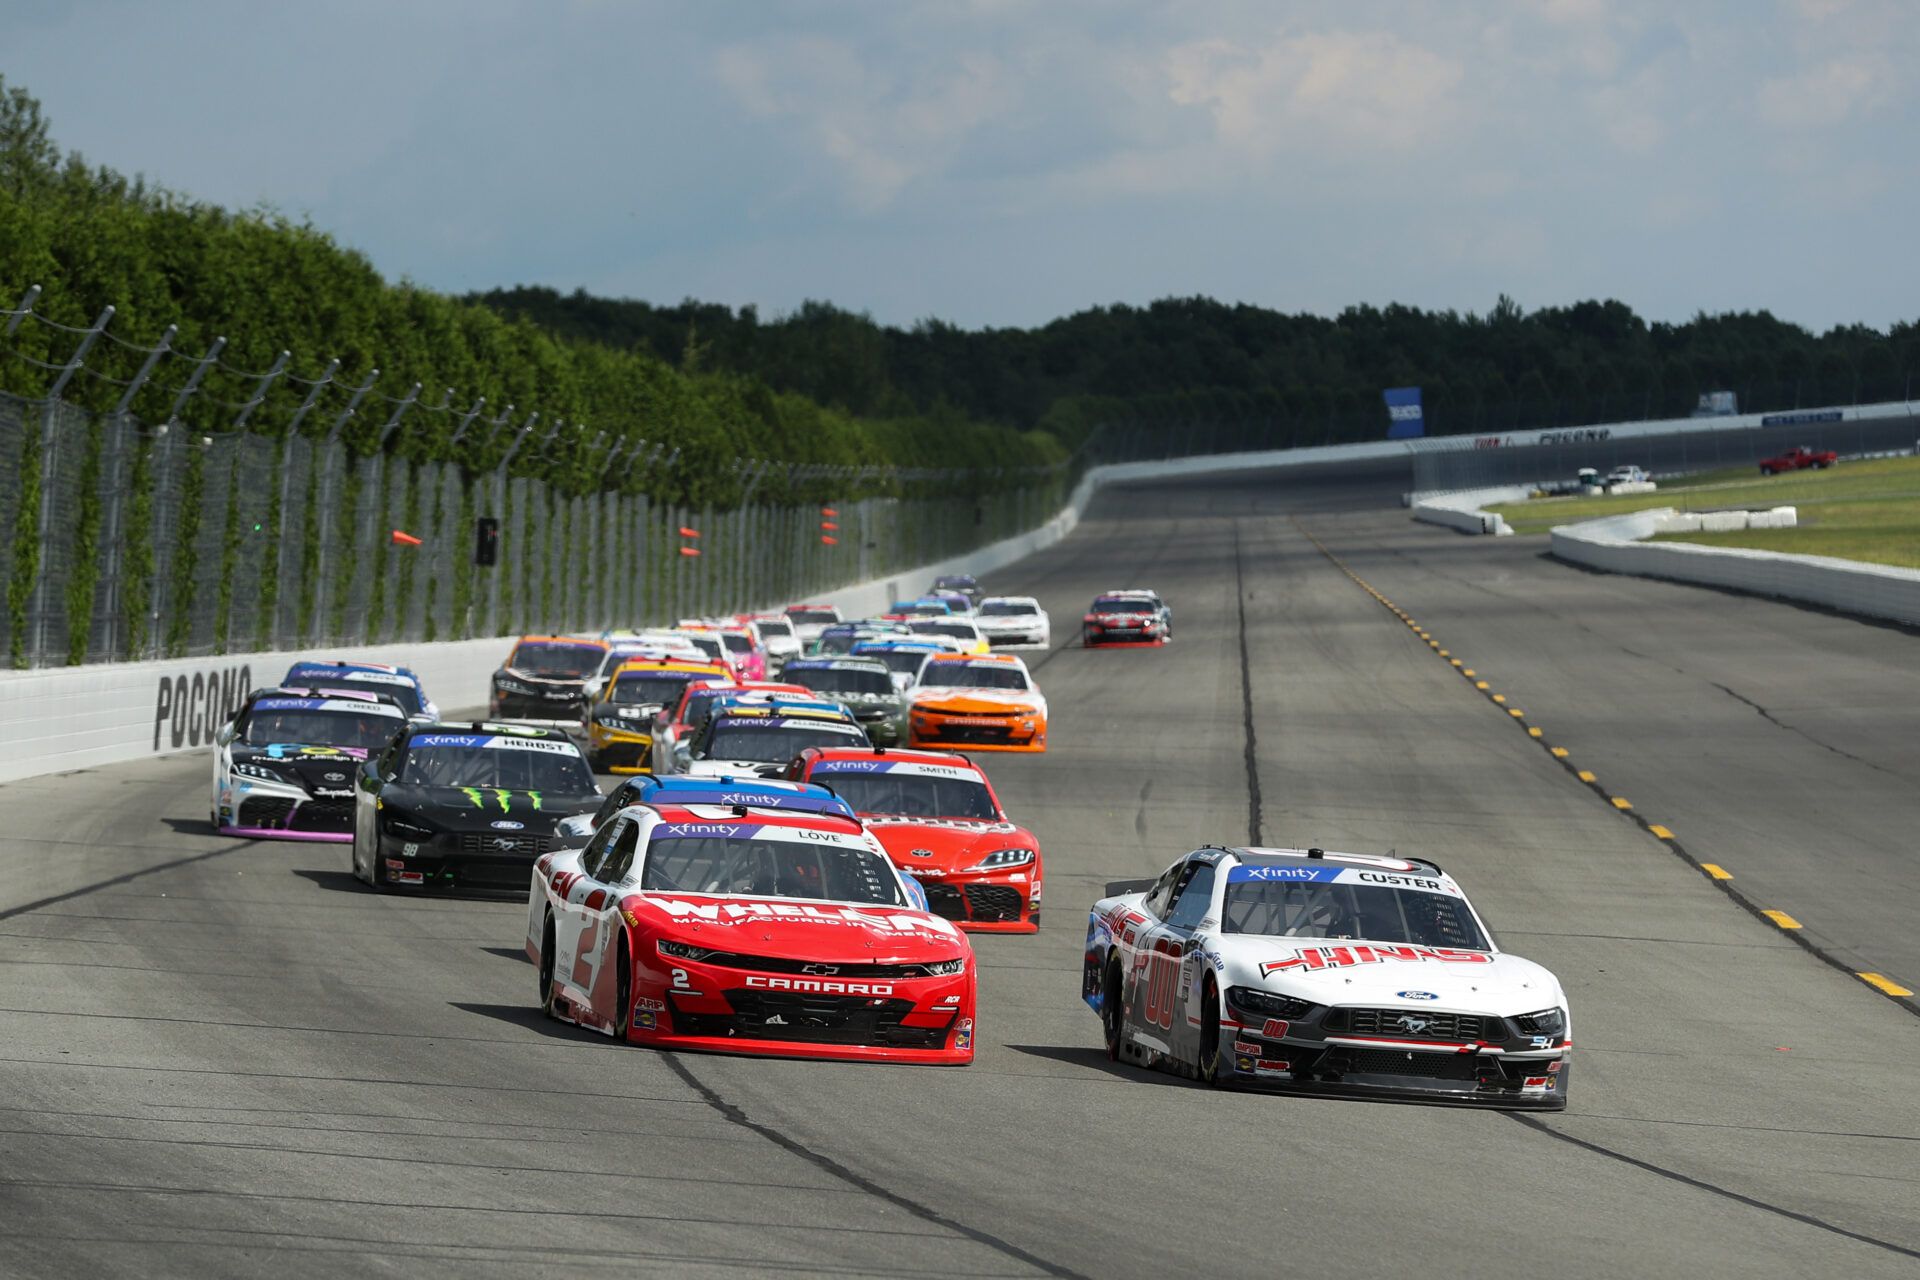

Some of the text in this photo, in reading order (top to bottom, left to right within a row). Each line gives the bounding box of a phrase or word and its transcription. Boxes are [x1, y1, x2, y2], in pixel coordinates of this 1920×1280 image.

[266, 699, 312, 709] xfinity
[728, 718, 773, 727] xfinity
[424, 735, 565, 751] xfinity HERBST
[826, 761, 957, 776] xfinity SMITH
[722, 793, 782, 806] xfinity
[668, 823, 842, 843] xfinity LOVE
[402, 843, 419, 857] 98
[1248, 867, 1442, 892] xfinity CUSTER
[641, 897, 958, 937] WHELEN
[672, 917, 867, 928] MANUFACTURED IN
[672, 968, 690, 988] 2
[745, 976, 893, 996] CAMARO
[635, 997, 665, 1010] ARP
[1403, 992, 1433, 1001] Ford
[1262, 1018, 1290, 1039] 00
